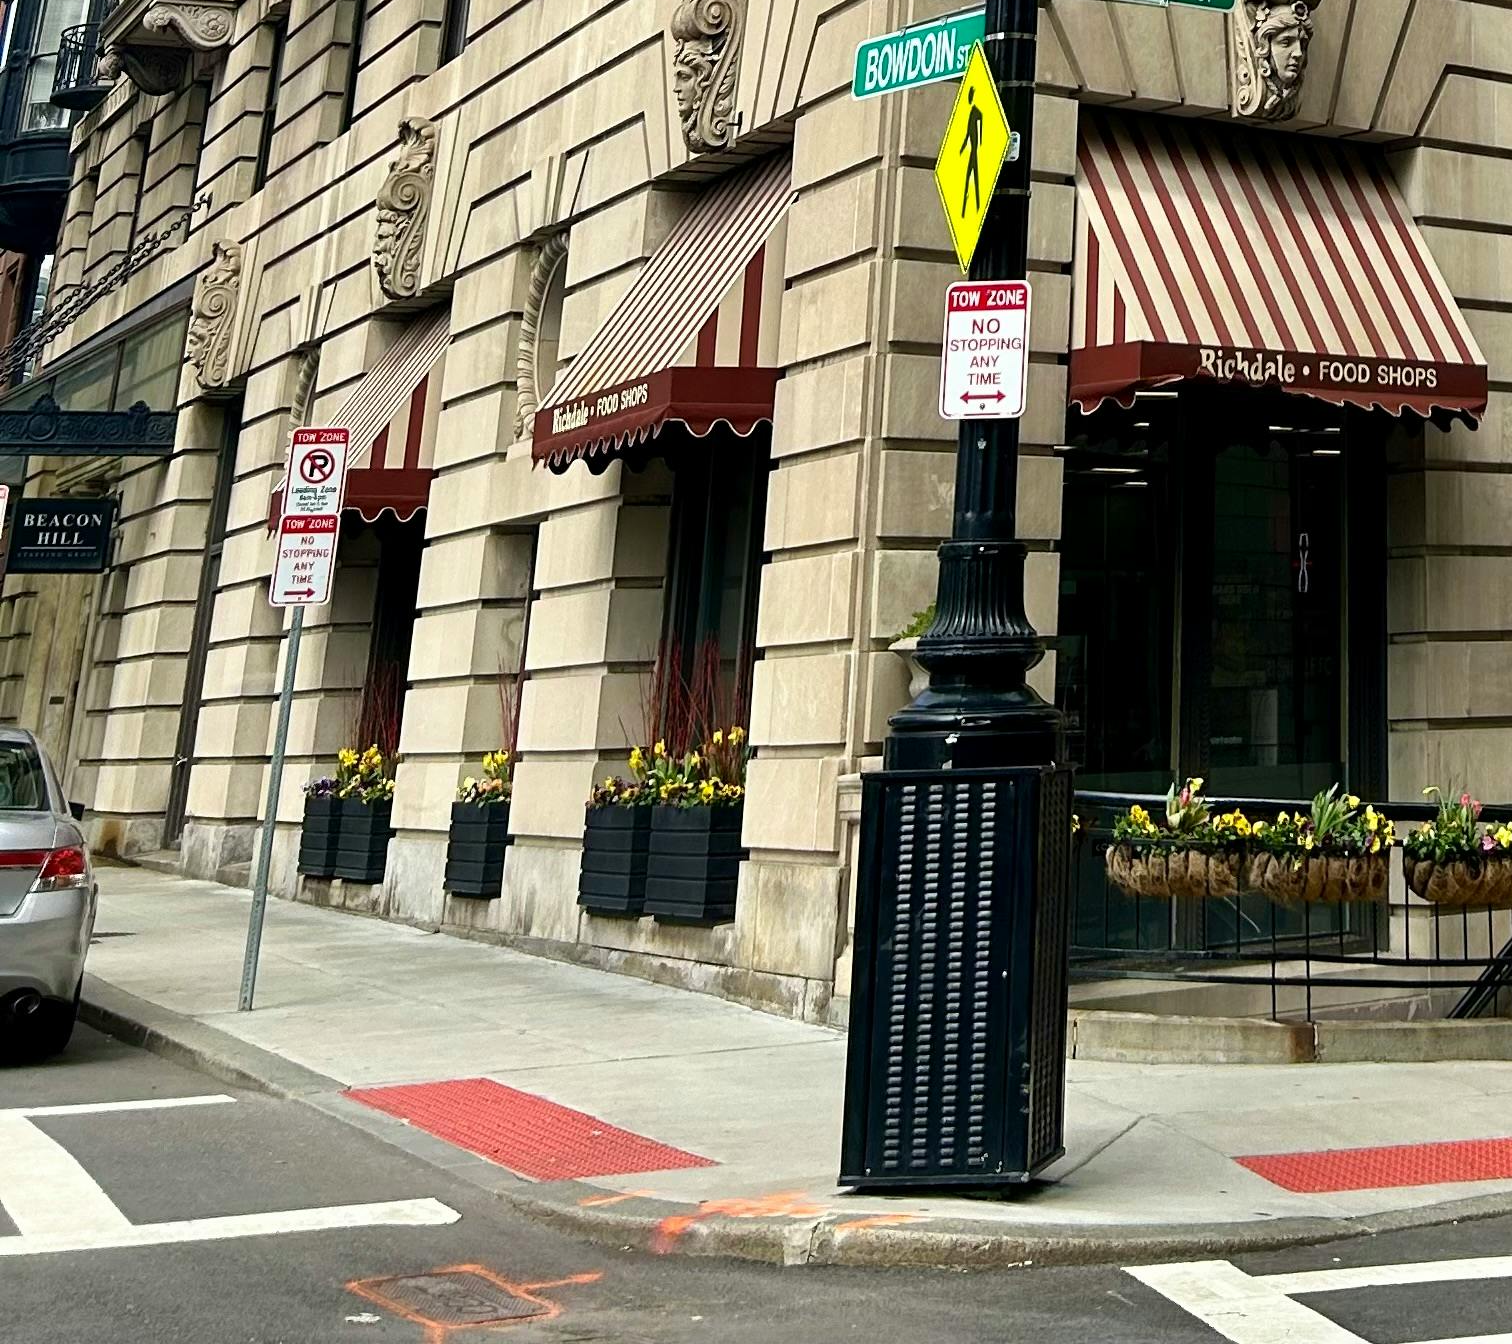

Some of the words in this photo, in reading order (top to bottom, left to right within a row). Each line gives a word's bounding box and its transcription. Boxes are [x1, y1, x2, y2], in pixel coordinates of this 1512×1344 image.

[864, 28, 956, 91] BOWDOIN
[956, 44, 971, 69] ST
[951, 291, 980, 308] TOW
[986, 289, 1025, 306] ZONE
[972, 318, 1001, 334] NO
[950, 337, 1022, 352] STOPPING
[970, 355, 1000, 368] ANY
[1200, 349, 1296, 383] Richdale
[1319, 361, 1371, 383] FOOD
[1377, 365, 1437, 388] SHOPS
[967, 372, 1001, 386] TIME
[552, 400, 589, 434] Richdale
[597, 393, 619, 418] FOOD
[620, 383, 649, 410] SHOPS
[298, 433, 317, 442] TOW
[320, 432, 346, 442] ZONE
[24, 513, 103, 527] BEACON
[286, 519, 306, 529] TOW
[308, 519, 335, 529] ZONE
[37, 532, 84, 545] HILL
[301, 536, 315, 545] NO
[282, 548, 330, 558] STOPPING
[294, 561, 315, 571] ANY
[292, 575, 313, 585] TIME
